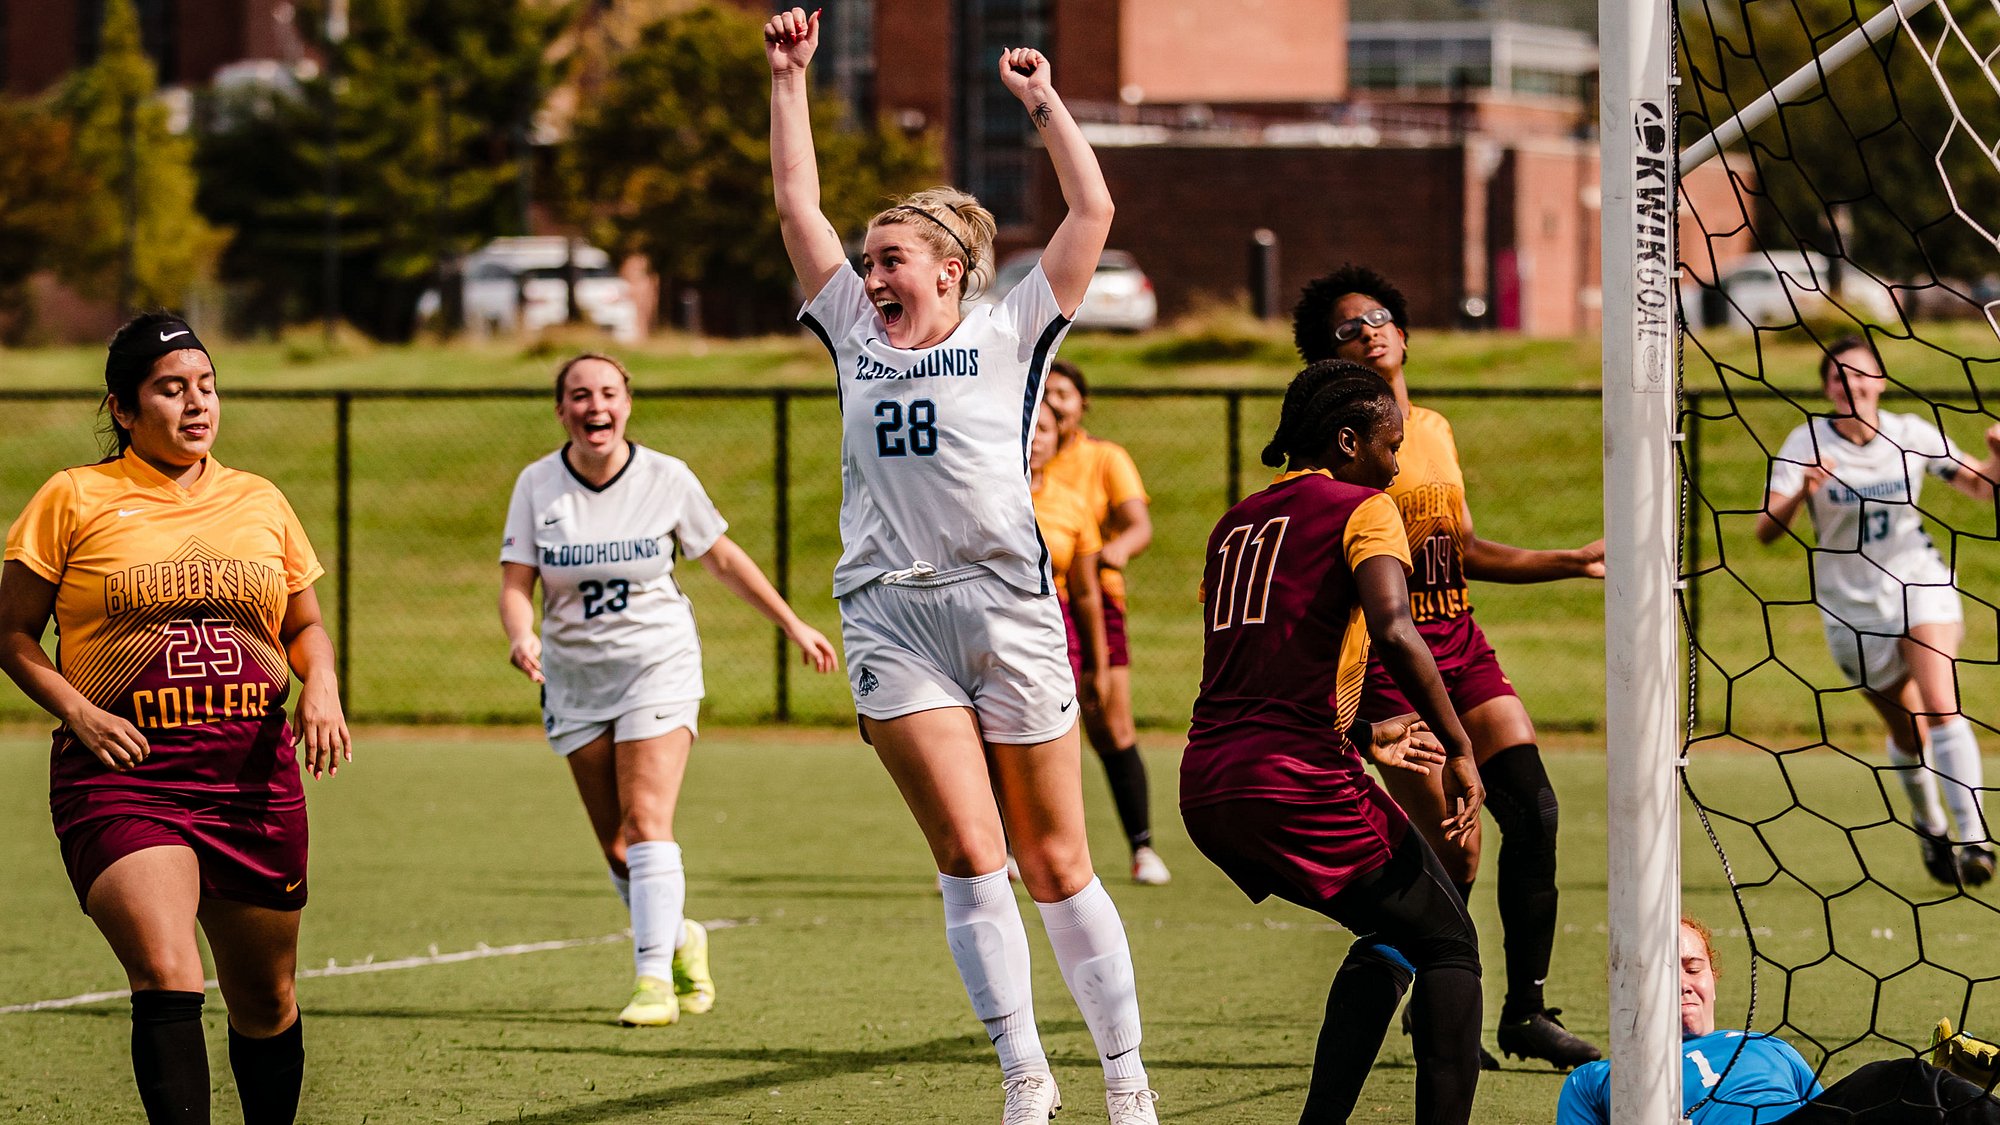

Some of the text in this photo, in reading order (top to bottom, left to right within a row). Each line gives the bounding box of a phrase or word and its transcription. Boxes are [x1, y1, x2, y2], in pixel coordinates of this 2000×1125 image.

[874, 399, 939, 457] 28
[1862, 510, 1889, 543] 13
[104, 559, 287, 618] BROOKLYN
[577, 578, 629, 619] 23
[1213, 516, 1290, 631] 11
[163, 618, 243, 679] 25
[133, 682, 270, 729] COLLEGE
[1685, 1049, 1721, 1088] 1
